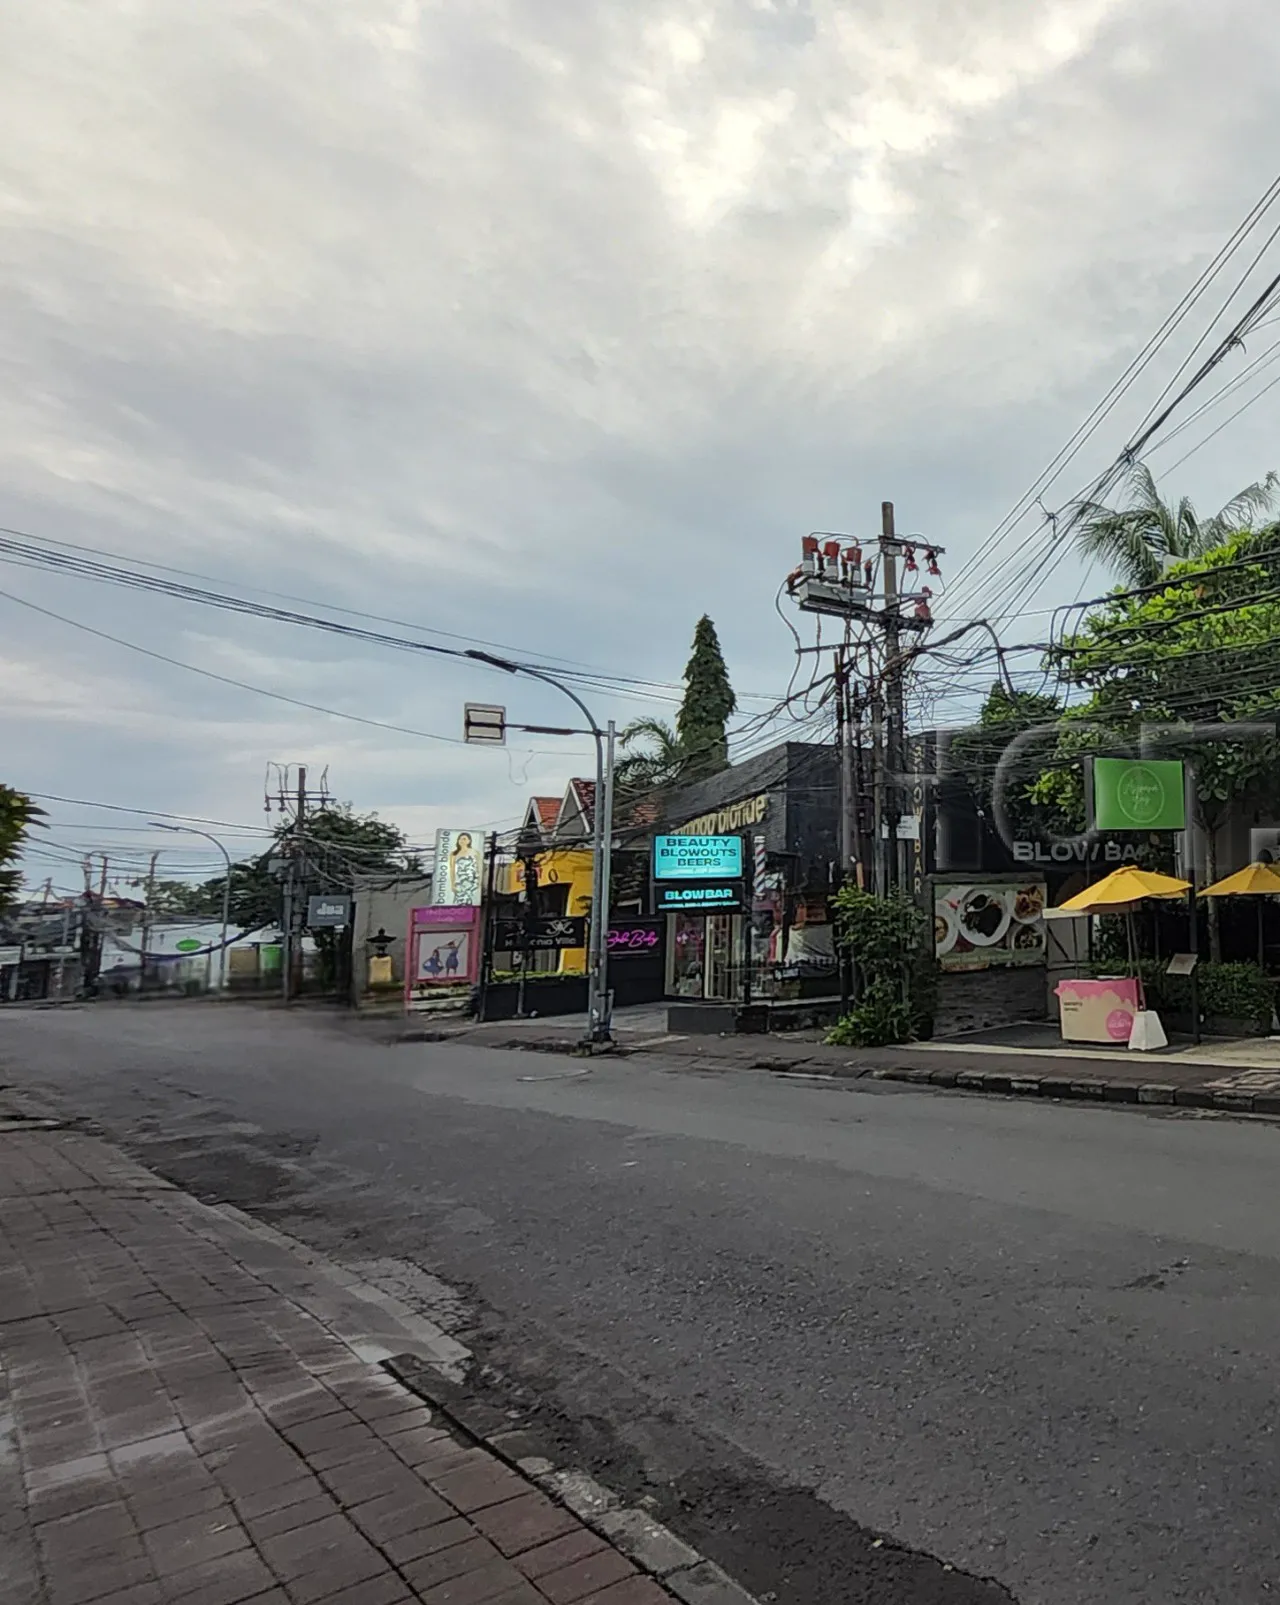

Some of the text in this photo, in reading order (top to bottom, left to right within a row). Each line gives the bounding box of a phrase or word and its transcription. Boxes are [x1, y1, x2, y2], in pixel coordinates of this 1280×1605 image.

[440, 831, 450, 863] blonde
[666, 838, 730, 848] BEAUTY
[1012, 840, 1101, 862] BLOW
[660, 848, 737, 858] BLOWOUTS
[677, 857, 721, 867] BEERS
[435, 865, 448, 904] bamboo
